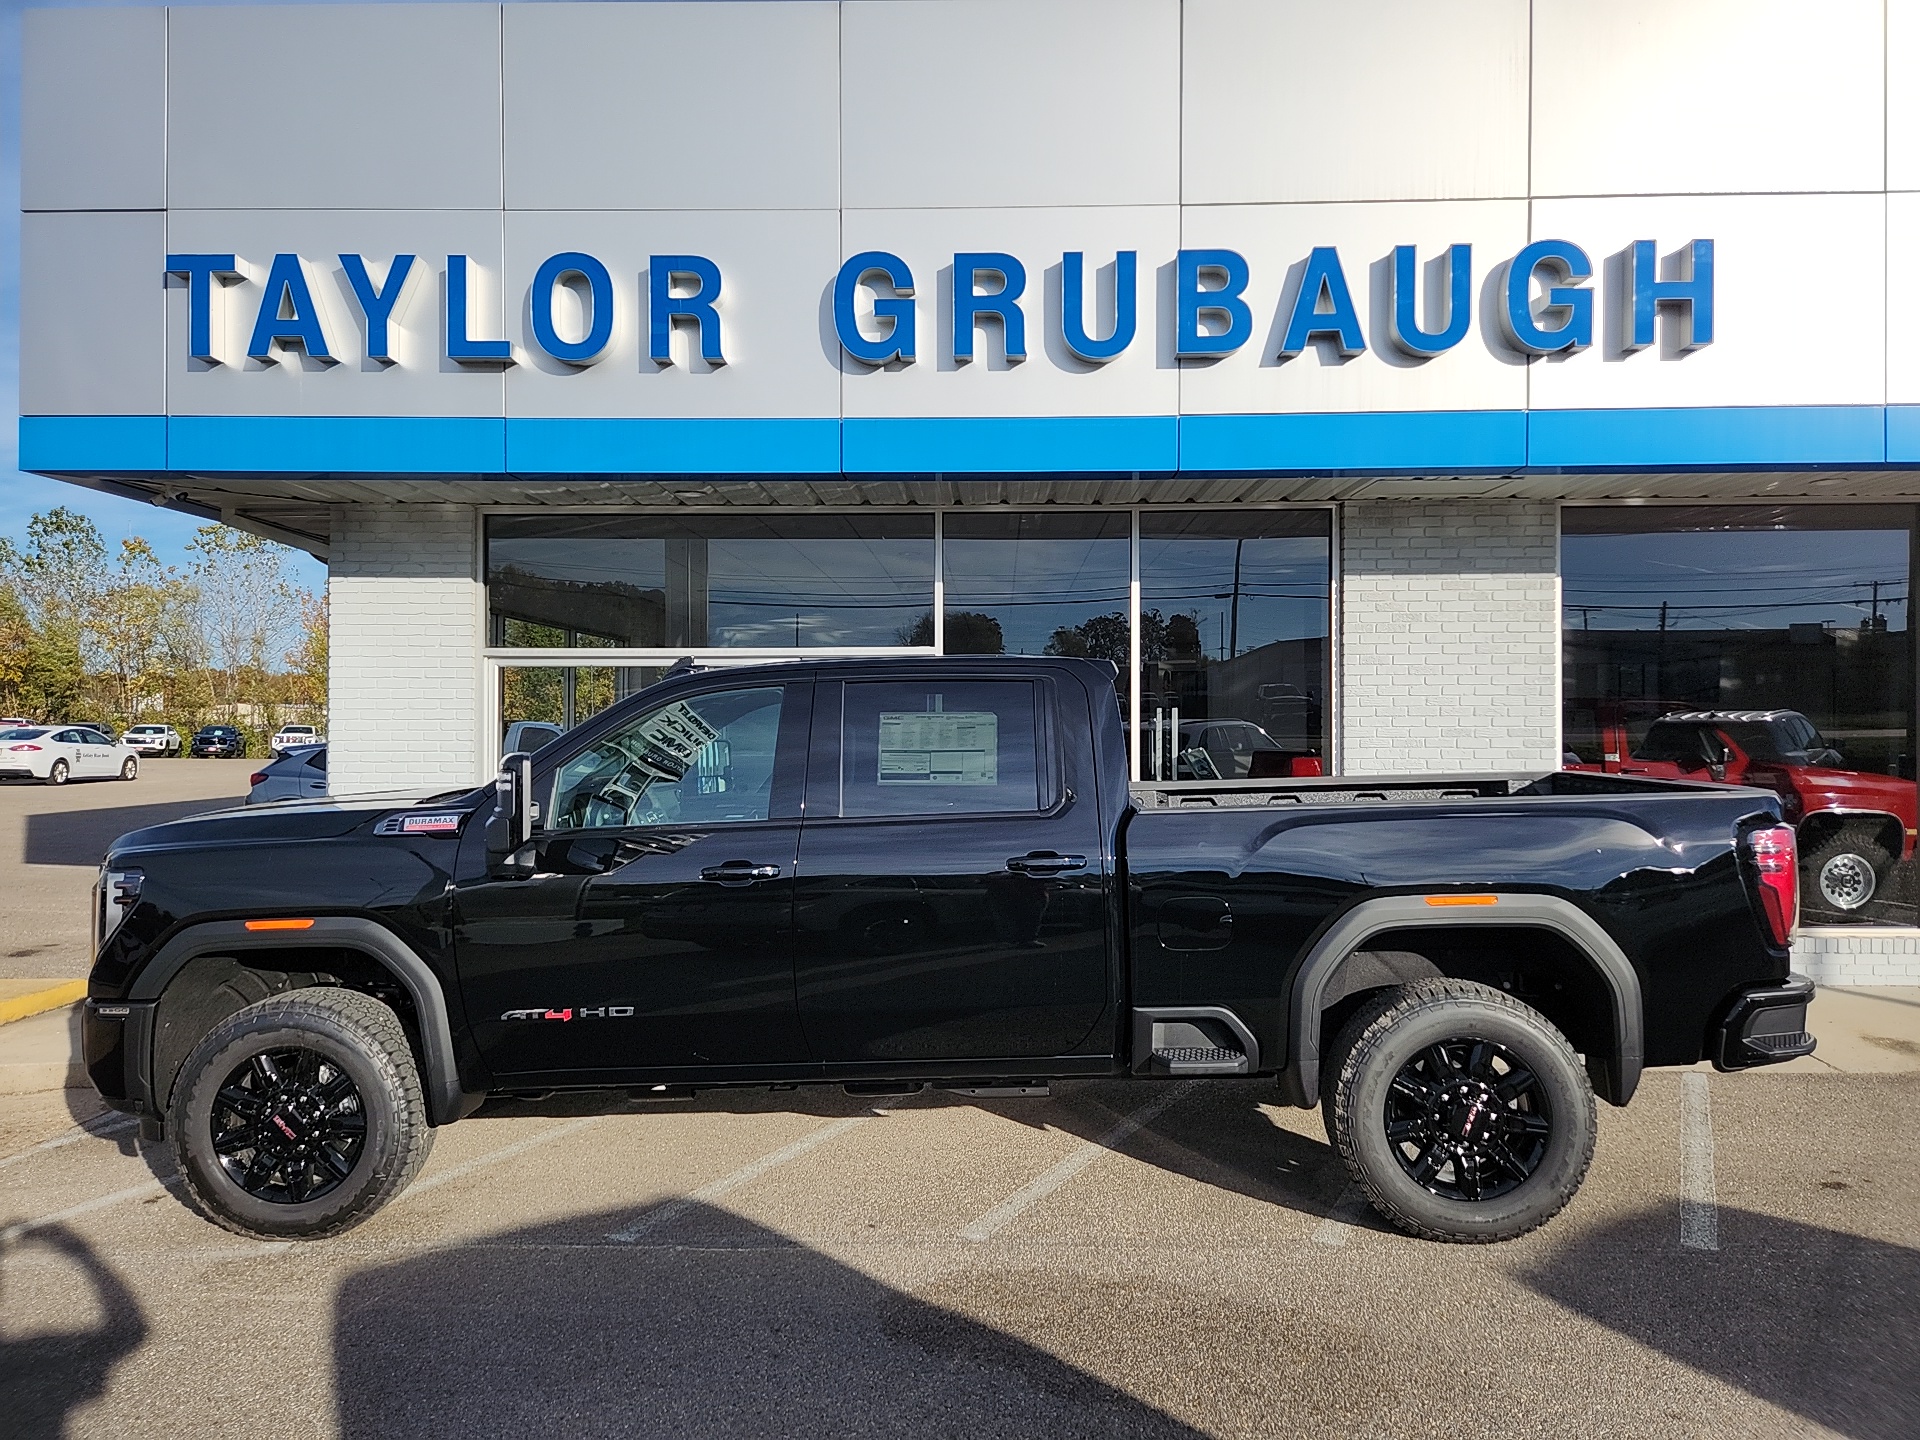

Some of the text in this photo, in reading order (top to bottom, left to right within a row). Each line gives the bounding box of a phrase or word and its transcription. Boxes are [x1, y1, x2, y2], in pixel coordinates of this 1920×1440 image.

[166, 239, 1715, 366] TAYLOR GRUBAUGH
[408, 817, 454, 825] DURAMAX
[501, 1006, 635, 1022] AT4 HD
